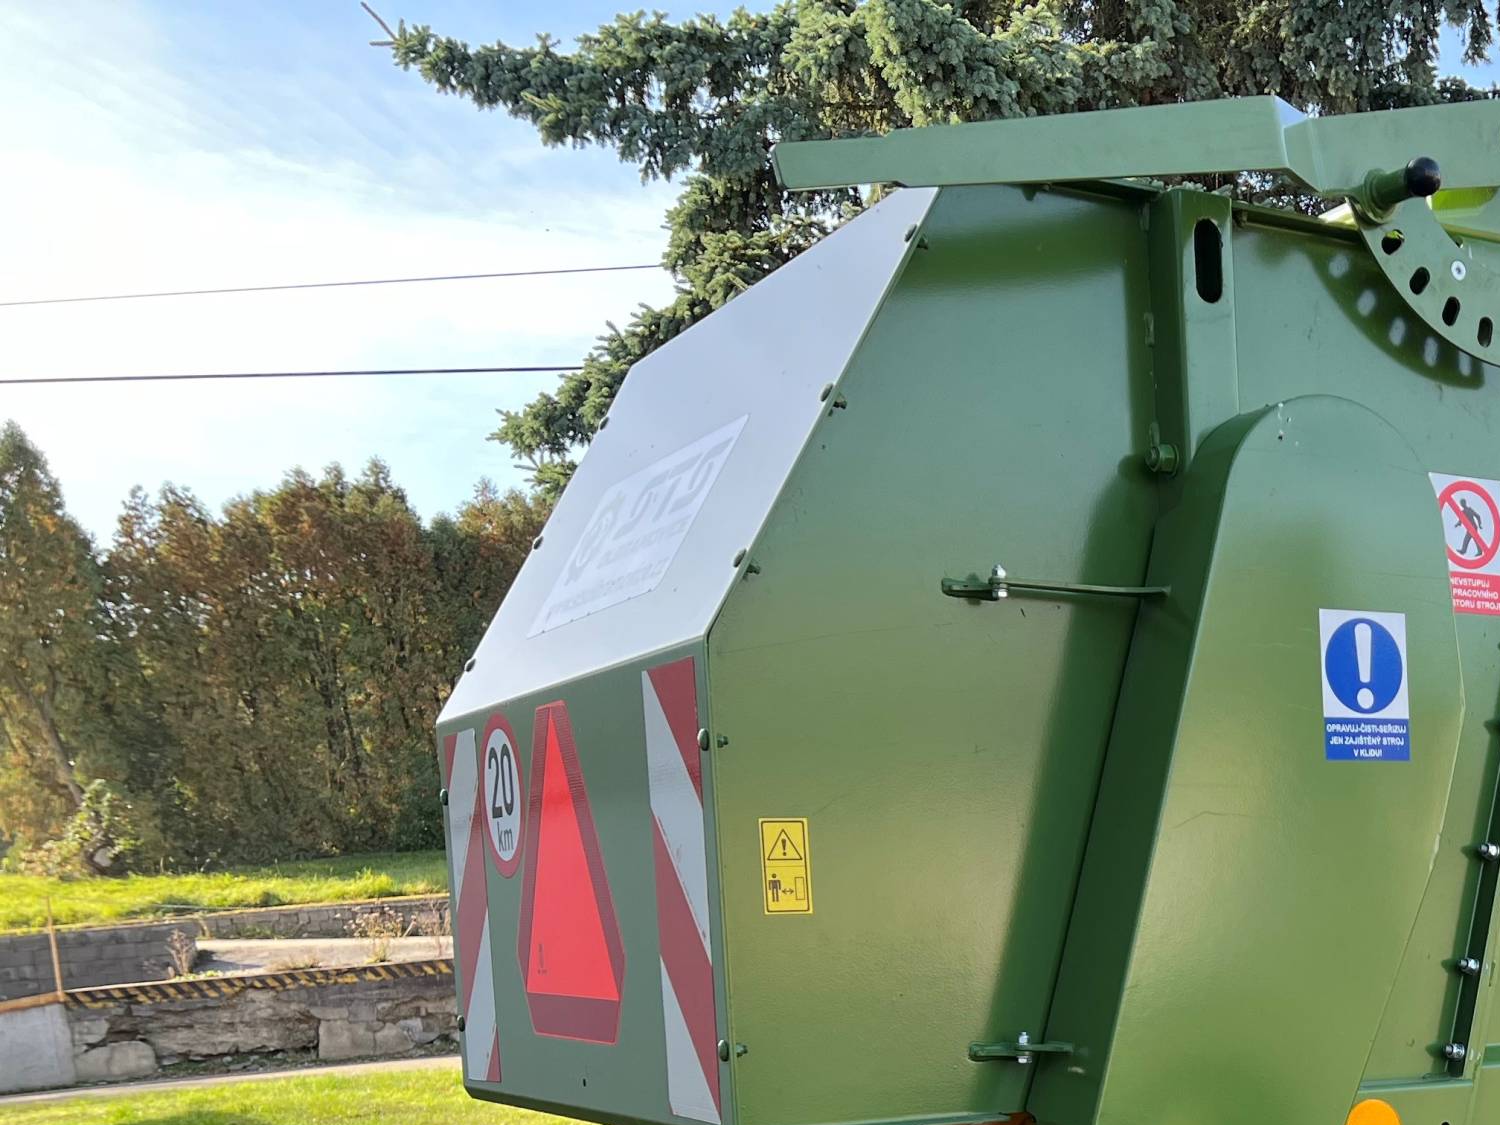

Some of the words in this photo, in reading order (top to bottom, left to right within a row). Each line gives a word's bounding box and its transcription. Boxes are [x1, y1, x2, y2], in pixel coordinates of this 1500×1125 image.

[1453, 588, 1499, 600] PRACOVNÍHO
[1329, 736, 1344, 745] JEN
[1382, 737, 1405, 746] STROJ
[1353, 749, 1359, 757] V
[488, 743, 515, 820] 20
[496, 820, 514, 852] km
